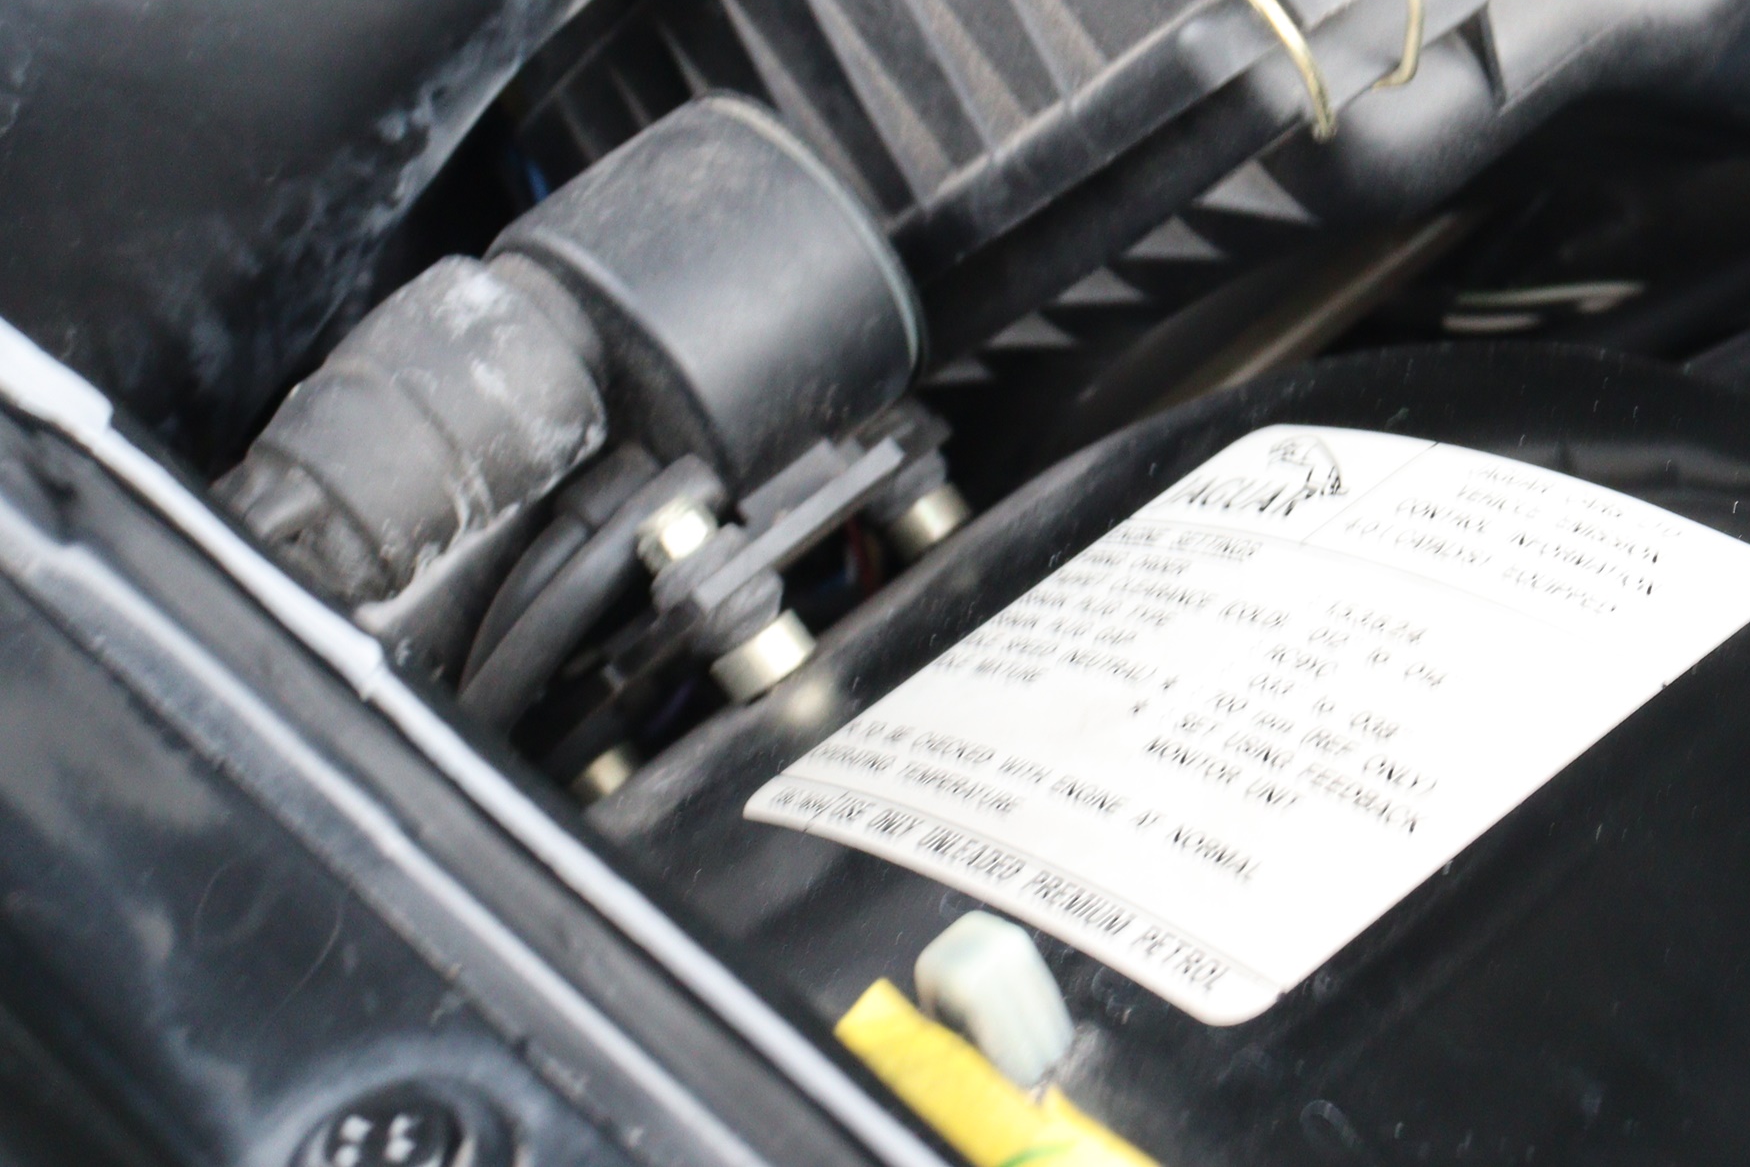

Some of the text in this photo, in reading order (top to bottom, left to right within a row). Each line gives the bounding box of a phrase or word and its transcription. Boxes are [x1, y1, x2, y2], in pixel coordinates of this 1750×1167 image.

[1148, 474, 1323, 517] JAGUAR
[1126, 553, 1196, 575] ORDER
[1169, 530, 1266, 557] SETTINGS
[1390, 494, 1668, 596] CONTROL INFORMATION
[1390, 526, 1498, 568] CATALYST
[1552, 514, 1672, 564] EMISSION
[1072, 594, 1126, 617] PLUG
[1123, 605, 1178, 628] TYPE
[1106, 575, 1219, 609] CLEARANCE
[1044, 616, 1097, 638] PLUG
[1090, 624, 1143, 647] GAP
[970, 656, 1051, 684] MIXTURE
[1214, 728, 1303, 772] USING
[1293, 759, 1433, 836] FEEDBACK
[1053, 647, 1162, 684] (NEUTRAL)
[1294, 721, 1369, 761] (REF
[1352, 749, 1447, 796] ONLY)
[892, 758, 1026, 815] TEMPERATURE
[1136, 733, 1310, 813] MONITOR UNIT
[908, 729, 1001, 766] CHECKED
[993, 754, 1056, 785] WITH
[1045, 773, 1133, 816] ENGINE
[1161, 821, 1271, 882] NORMAL
[826, 796, 1237, 992] USE ONLY UNLEADED PREMIUM PETROL
